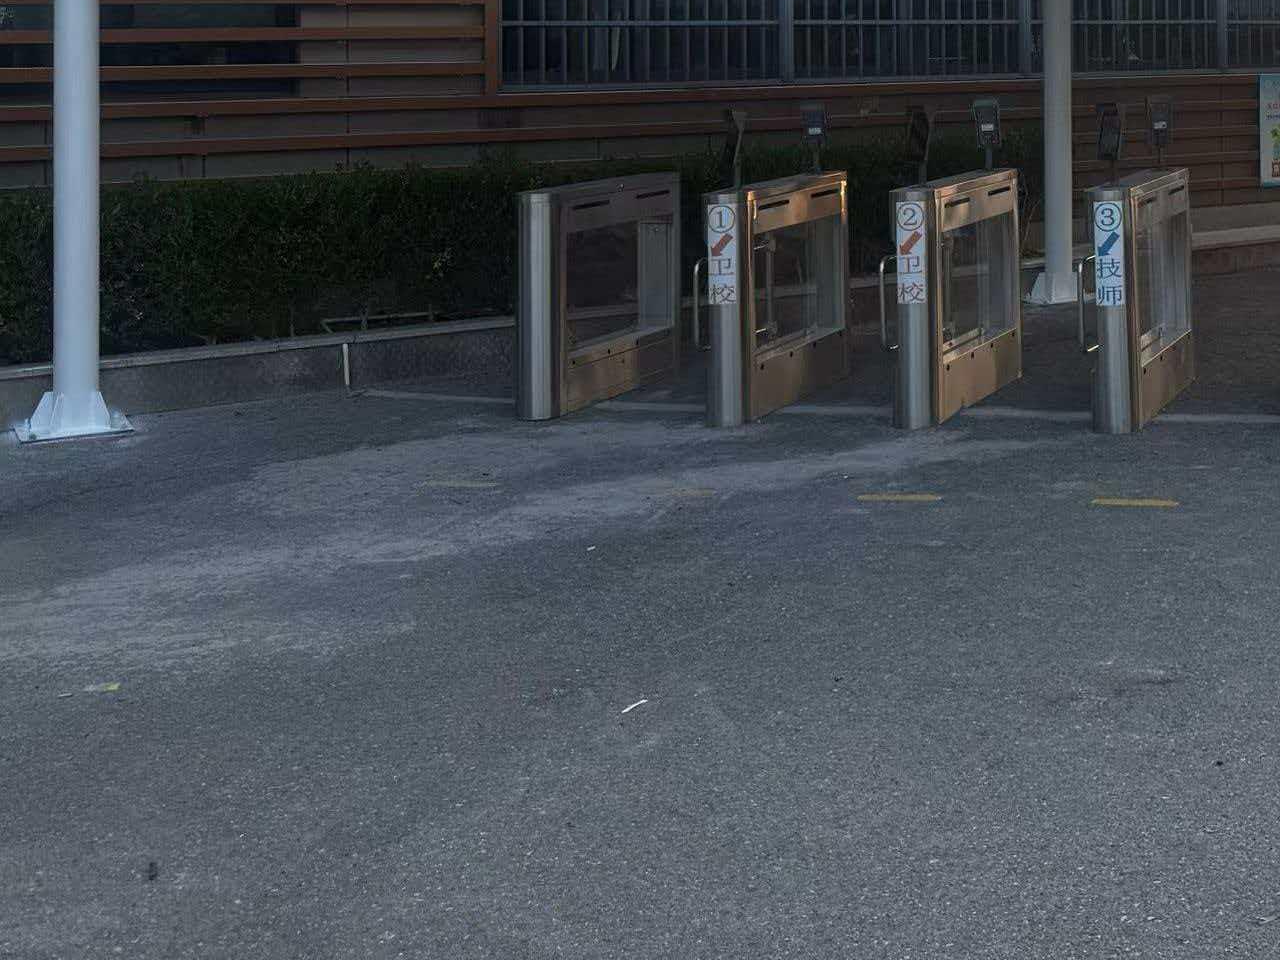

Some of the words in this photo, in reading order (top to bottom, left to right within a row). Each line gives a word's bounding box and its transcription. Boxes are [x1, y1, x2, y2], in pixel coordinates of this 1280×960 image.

[710, 258, 736, 304] 卫校
[899, 255, 925, 302] 卫校
[1096, 258, 1122, 305] 技师
